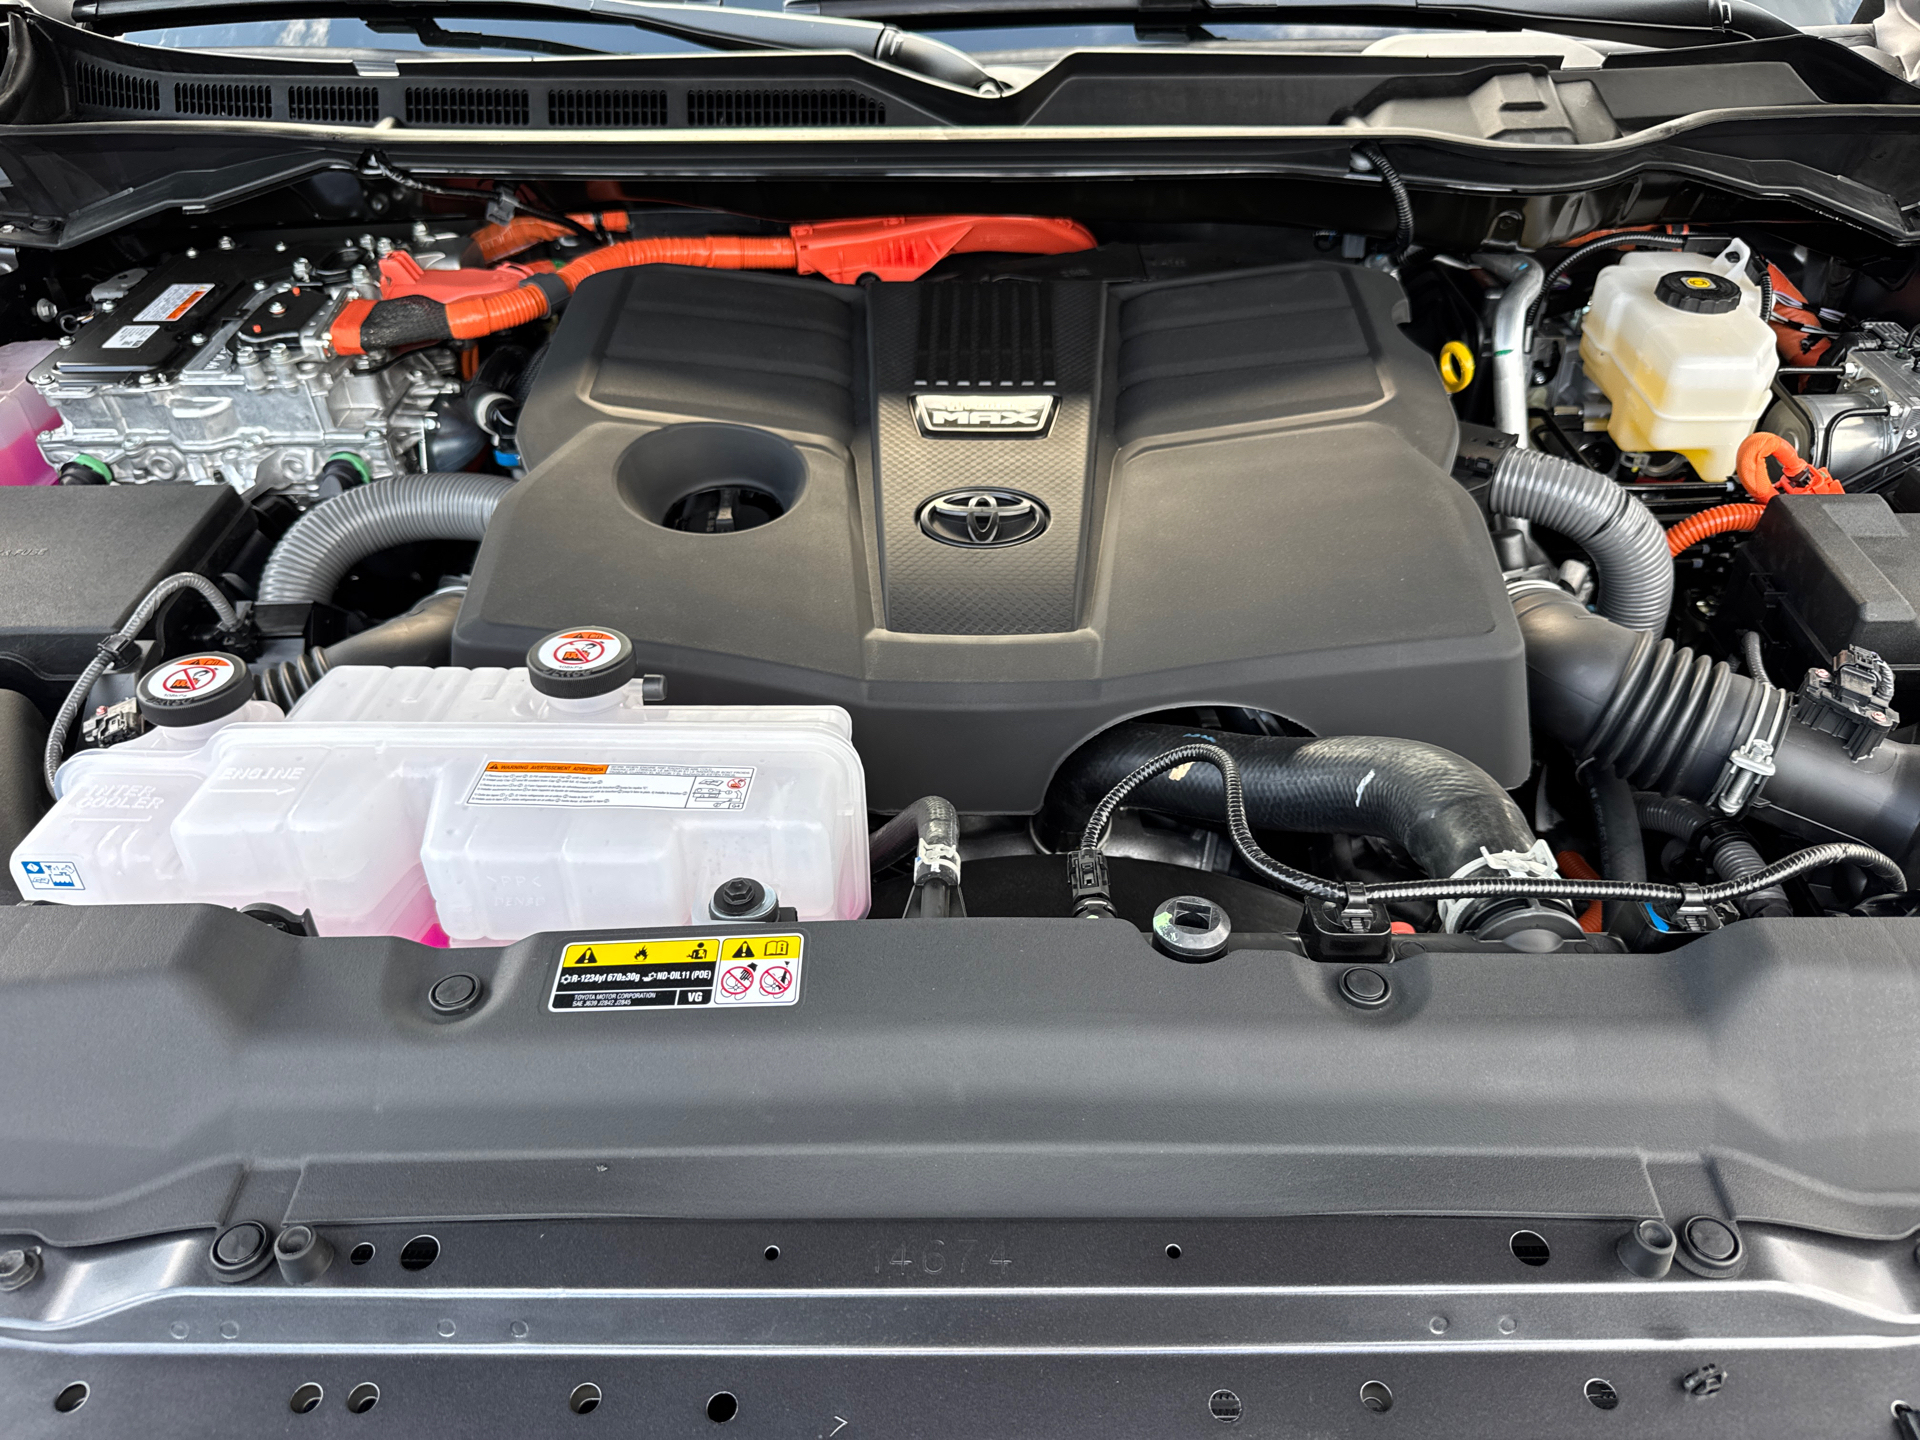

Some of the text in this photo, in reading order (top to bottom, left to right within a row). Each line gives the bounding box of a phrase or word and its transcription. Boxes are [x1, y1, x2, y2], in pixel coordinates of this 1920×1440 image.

[932, 410, 1039, 425] MAX
[218, 766, 306, 780] ENGINE
[85, 784, 157, 797] INTER
[77, 796, 164, 809] COOLER
[691, 970, 712, 981] (POE)
[574, 993, 596, 1001] TOYOTA
[687, 992, 703, 1002] VG
[868, 1239, 1013, 1275] 14674
